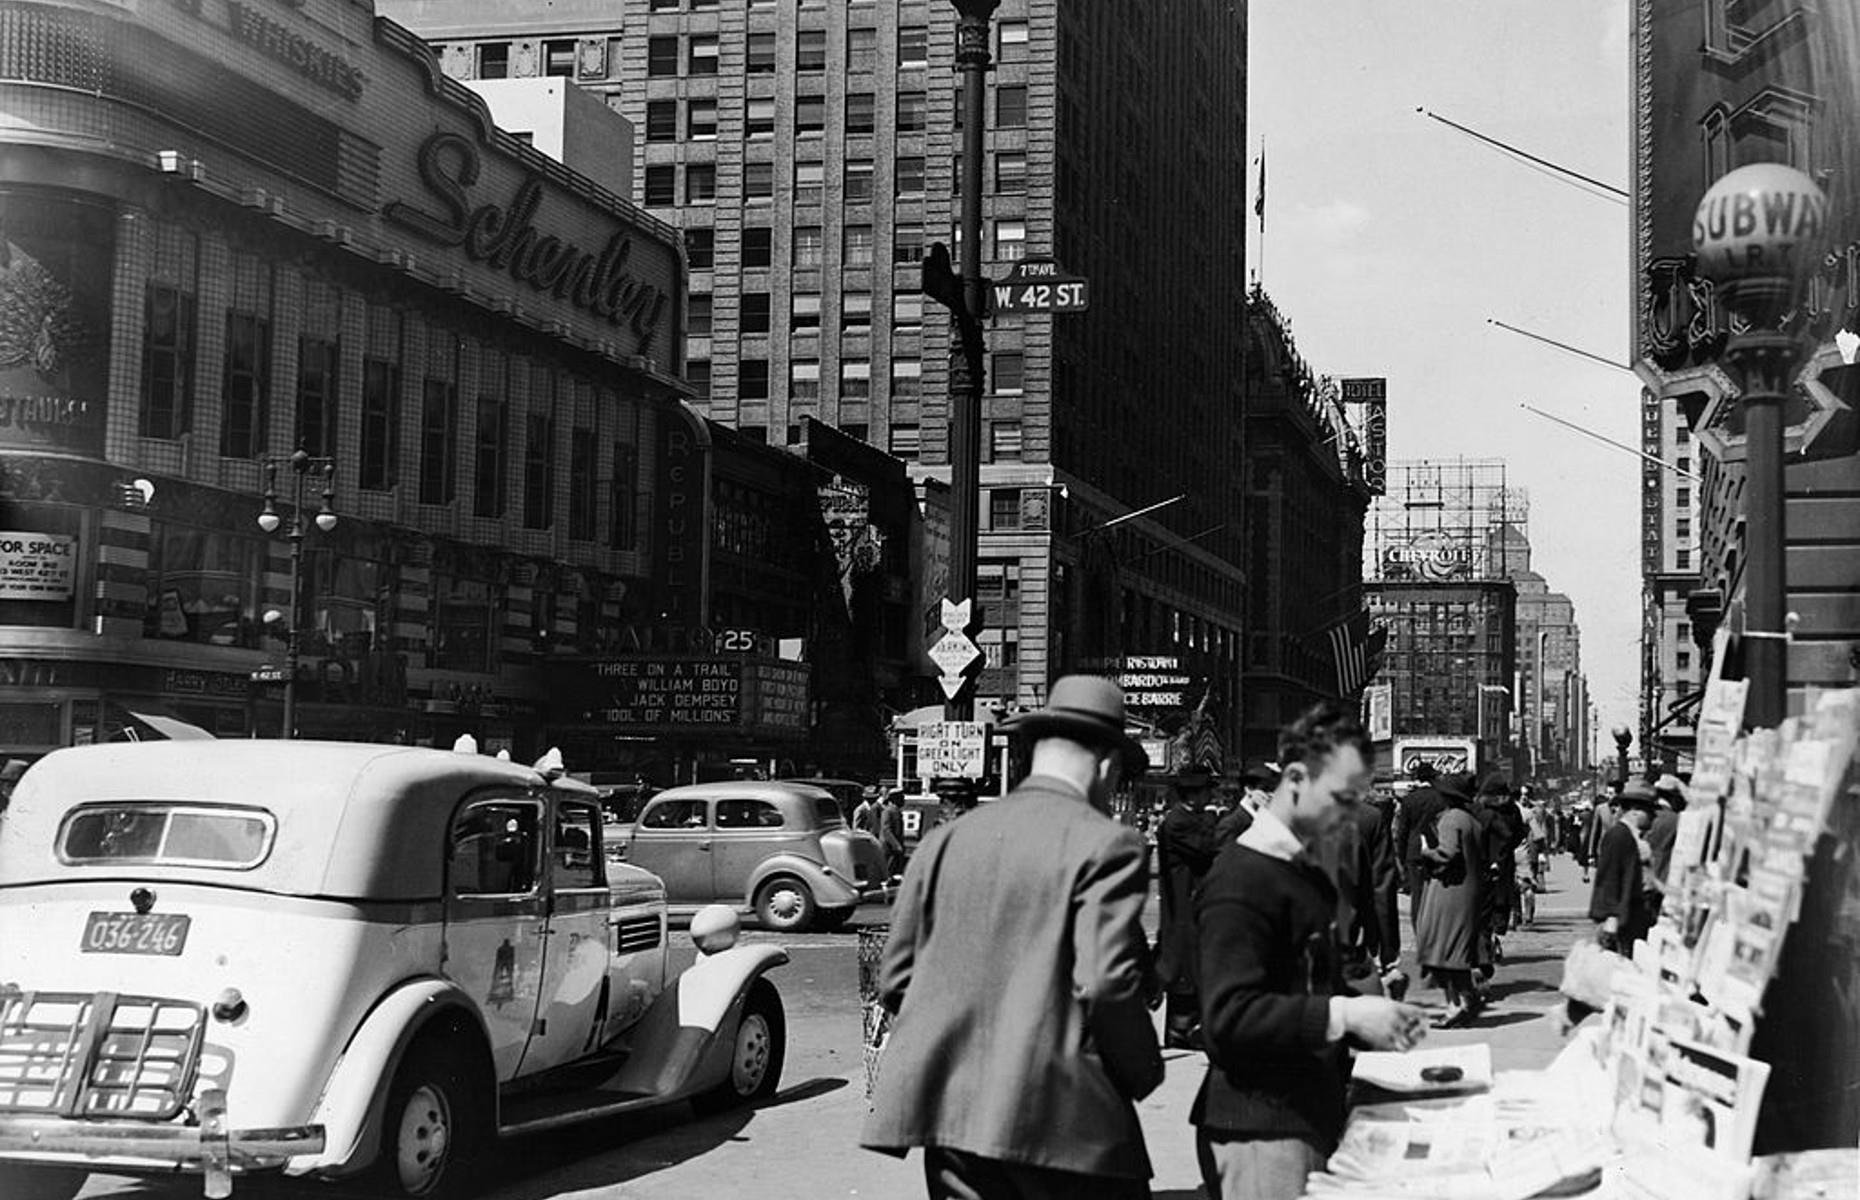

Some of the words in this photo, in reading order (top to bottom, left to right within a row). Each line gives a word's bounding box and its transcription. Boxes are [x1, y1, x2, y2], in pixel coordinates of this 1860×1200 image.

[1020, 285, 1050, 308] 42
[1057, 283, 1085, 306] ST.
[1370, 404, 1386, 491] ASTOR
[29, 541, 70, 556] SPACE
[647, 663, 664, 676] ON
[673, 663, 682, 676] A
[638, 679, 693, 692] WILLIAM
[702, 679, 738, 692] BOYD
[629, 694, 666, 707] JACK
[674, 694, 736, 707] DEMPSEY
[644, 709, 661, 722] OF
[920, 723, 950, 739] RIGHT
[955, 722, 983, 739] TURN
[939, 740, 960, 748] ON
[919, 748, 949, 760] GREEN
[951, 748, 980, 760] LIGHT
[932, 761, 968, 773] ONLY
